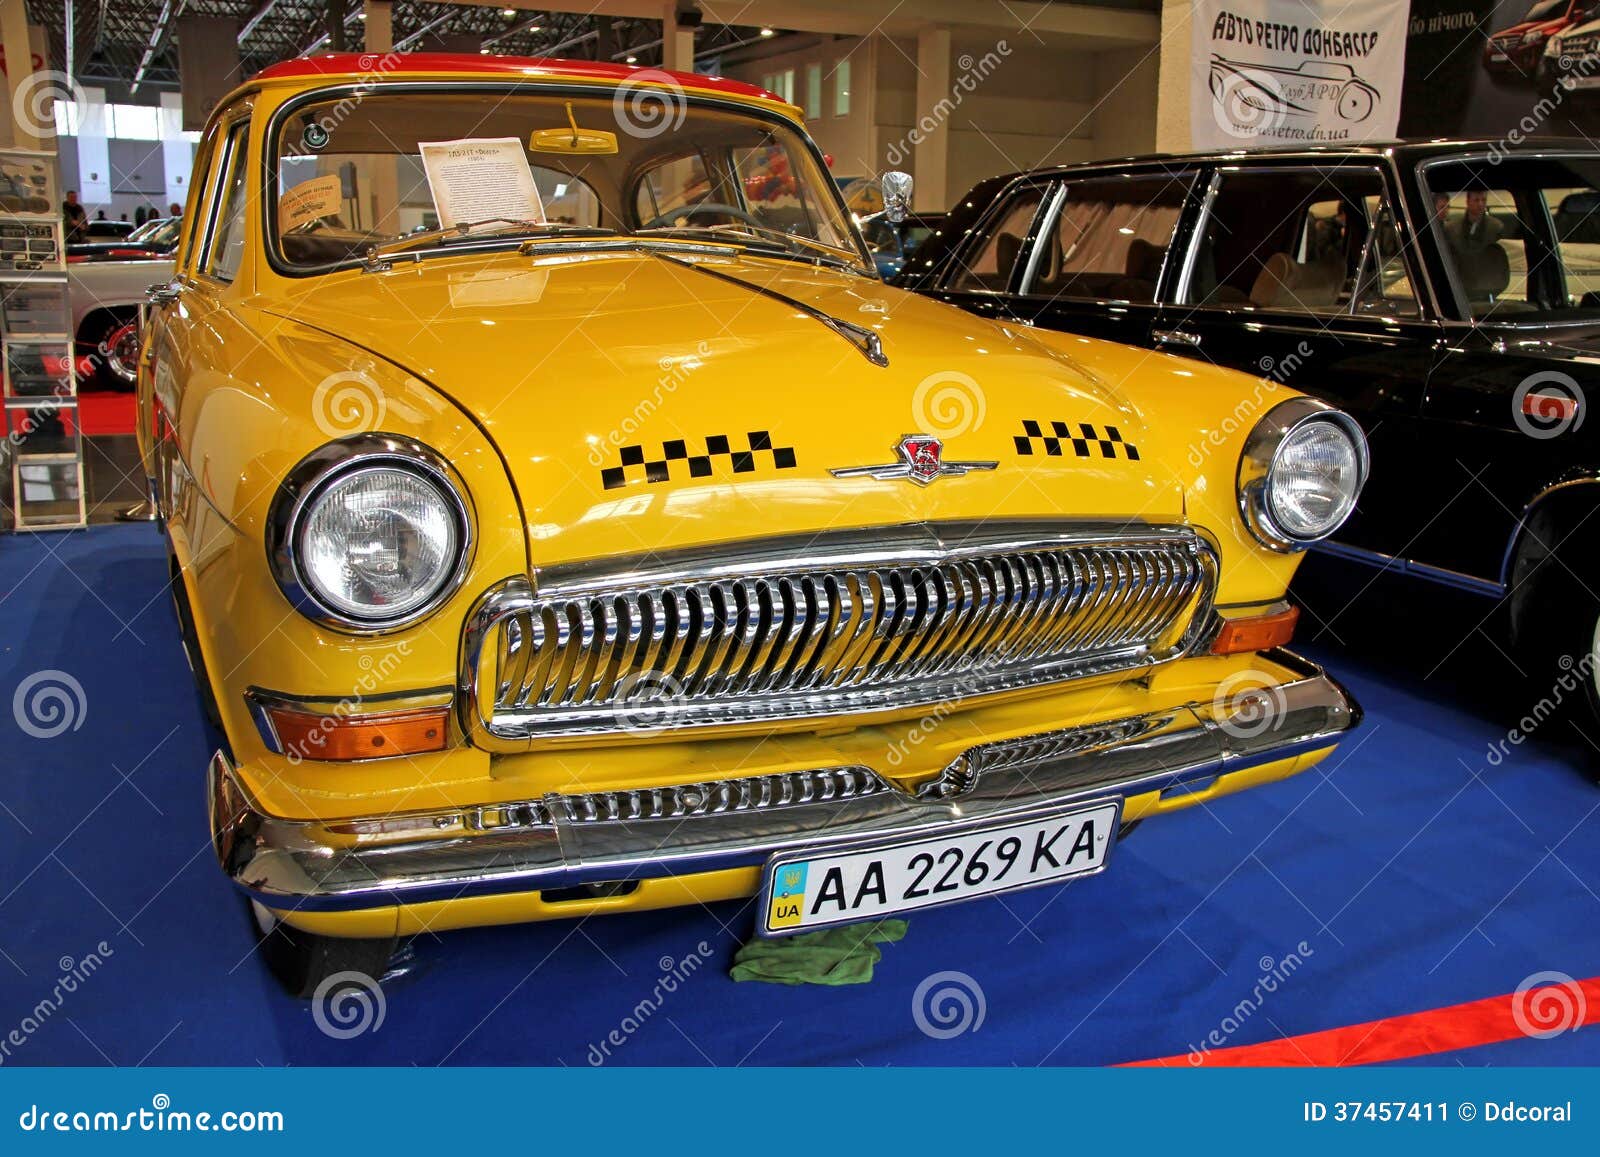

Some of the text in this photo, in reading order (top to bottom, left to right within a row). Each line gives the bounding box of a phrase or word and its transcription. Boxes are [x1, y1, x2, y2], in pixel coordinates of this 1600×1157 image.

[1212, 11, 1253, 45] АВТО
[1256, 21, 1299, 53] РЕТРО
[1428, 11, 1477, 33] нічого.
[810, 819, 1096, 915] AA 2269 KA
[776, 905, 800, 919] UA
